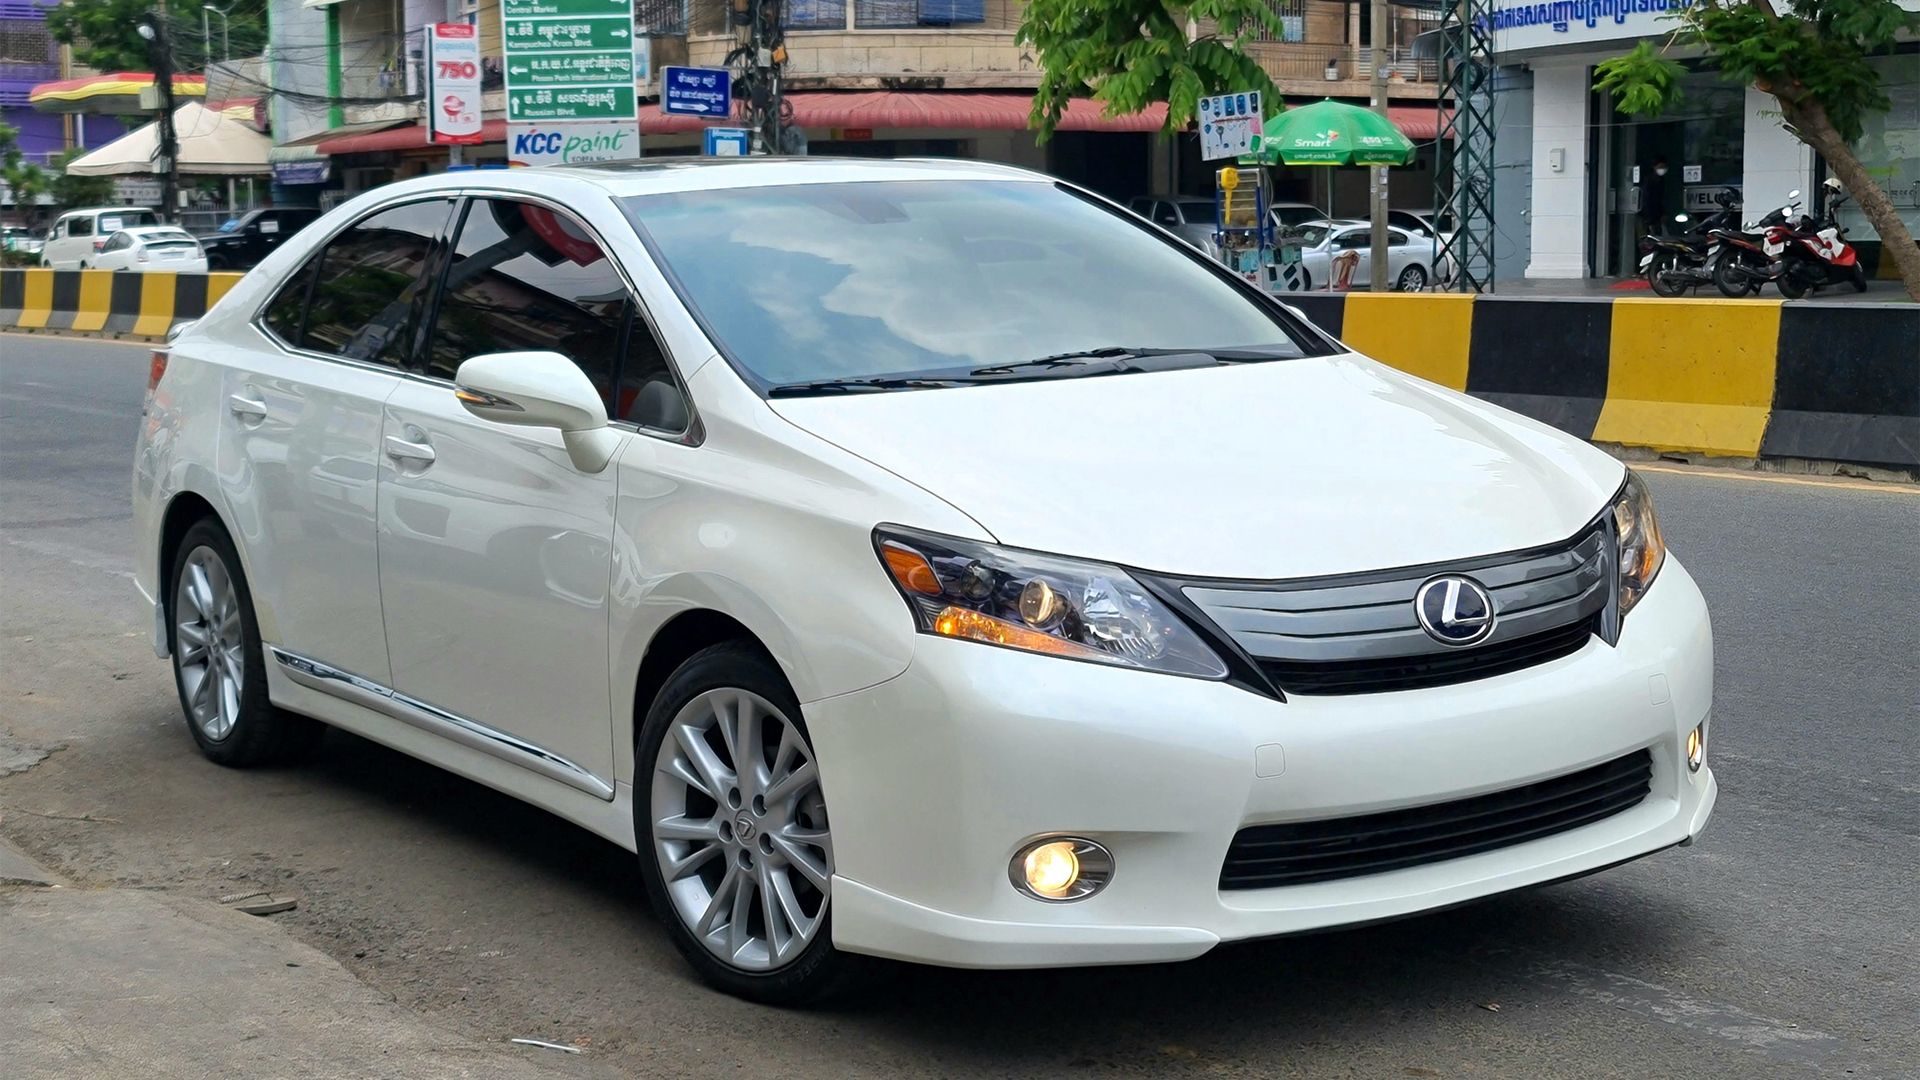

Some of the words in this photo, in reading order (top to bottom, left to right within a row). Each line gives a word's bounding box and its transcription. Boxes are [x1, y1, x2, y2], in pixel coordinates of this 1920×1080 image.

[436, 61, 477, 79] 750
[609, 73, 631, 81] Airport
[514, 132, 562, 155] KCC
[563, 129, 630, 164] paint
[1295, 138, 1331, 147] Smart
[1294, 152, 1337, 160] smart.com.kh
